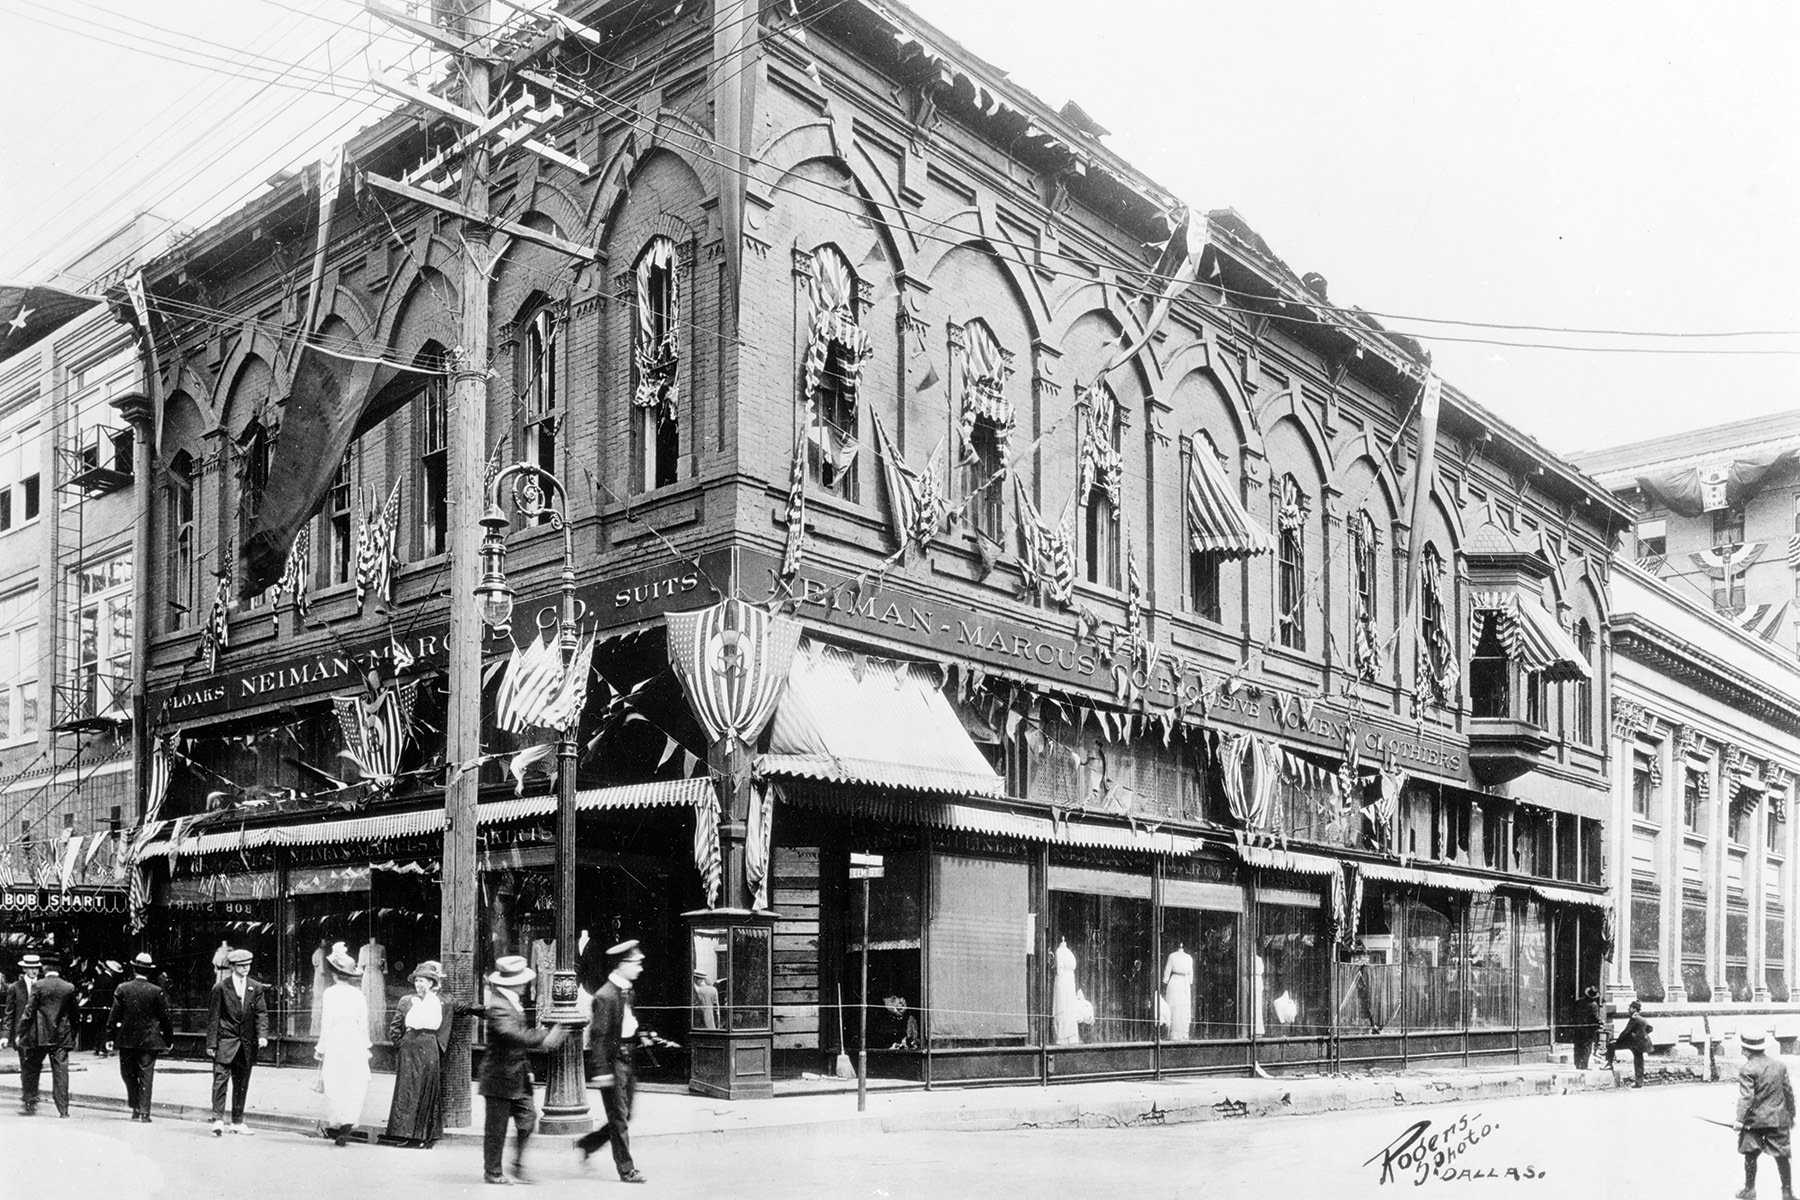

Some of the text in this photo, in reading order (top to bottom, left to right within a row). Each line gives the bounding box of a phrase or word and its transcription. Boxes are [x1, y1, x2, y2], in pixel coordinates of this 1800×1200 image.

[241, 616, 512, 698] NEIMAN-MARS
[615, 571, 699, 608] SUITS
[1157, 677, 1260, 718] ECUSIVE
[4, 893, 104, 908] BOB SMART
